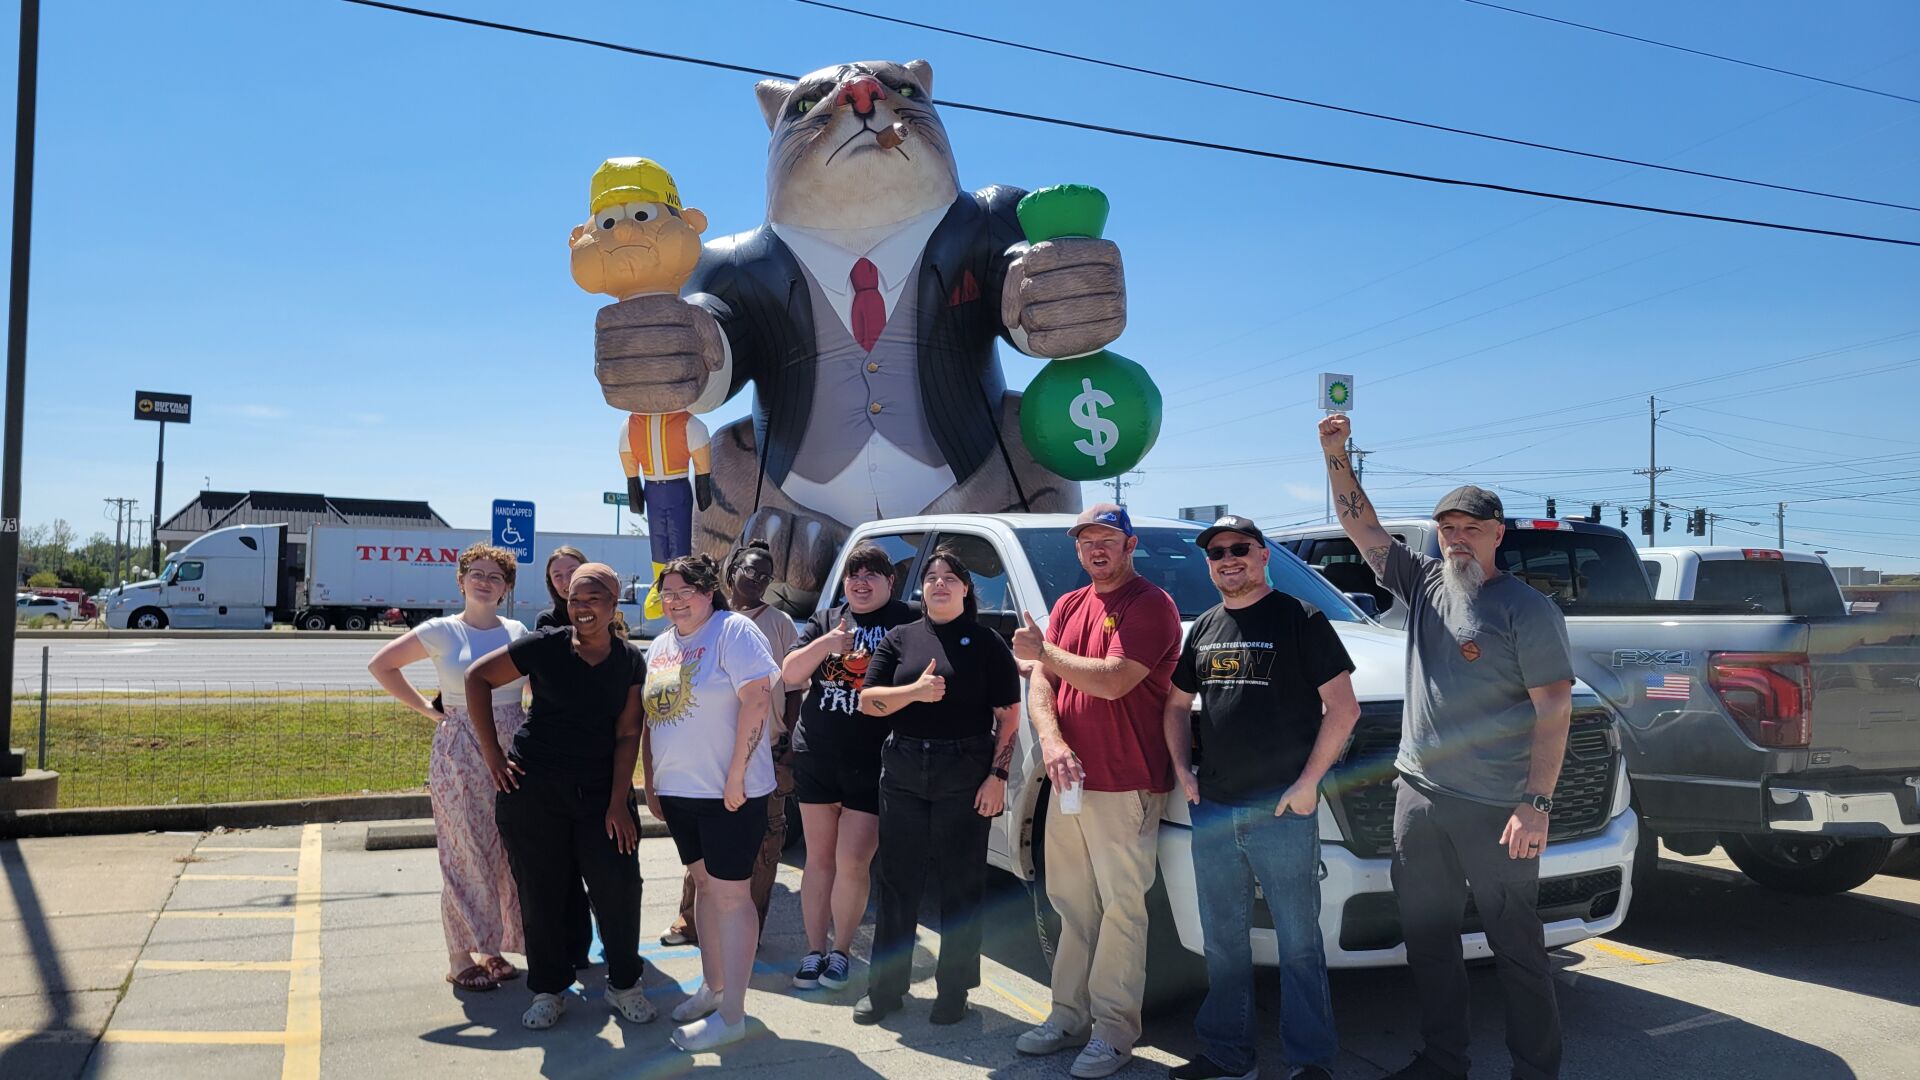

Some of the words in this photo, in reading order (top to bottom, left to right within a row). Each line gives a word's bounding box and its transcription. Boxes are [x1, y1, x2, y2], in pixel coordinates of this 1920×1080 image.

[154, 401, 189, 410] BUFFALO
[495, 506, 533, 518] HANDICAPPED
[356, 545, 460, 563] TITAN
[1196, 650, 1277, 680] USW
[1611, 648, 1692, 669] FX4
[819, 688, 861, 716] FRI
